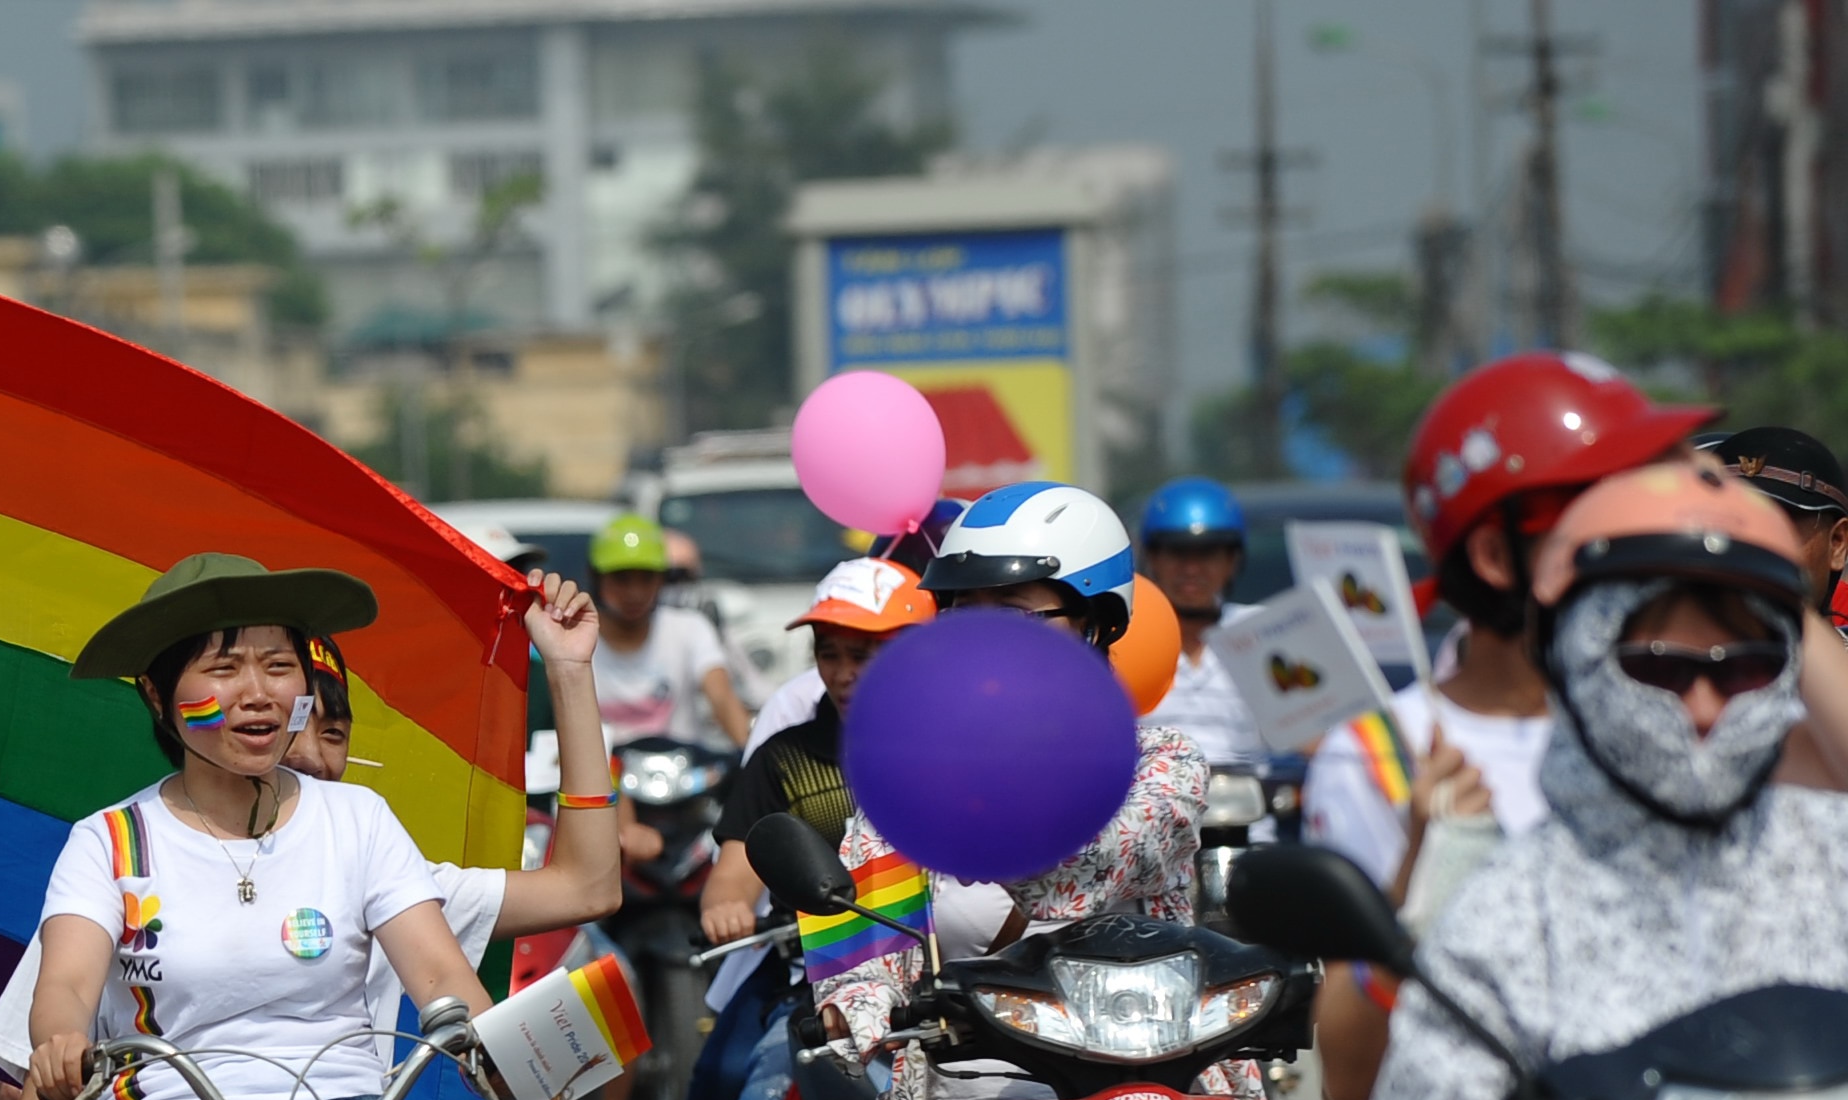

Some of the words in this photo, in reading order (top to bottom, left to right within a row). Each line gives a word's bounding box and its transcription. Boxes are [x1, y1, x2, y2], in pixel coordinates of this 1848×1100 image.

[119, 957, 163, 982] YMG
[550, 999, 573, 1031] Viet
[565, 1031, 582, 1054] Pride
